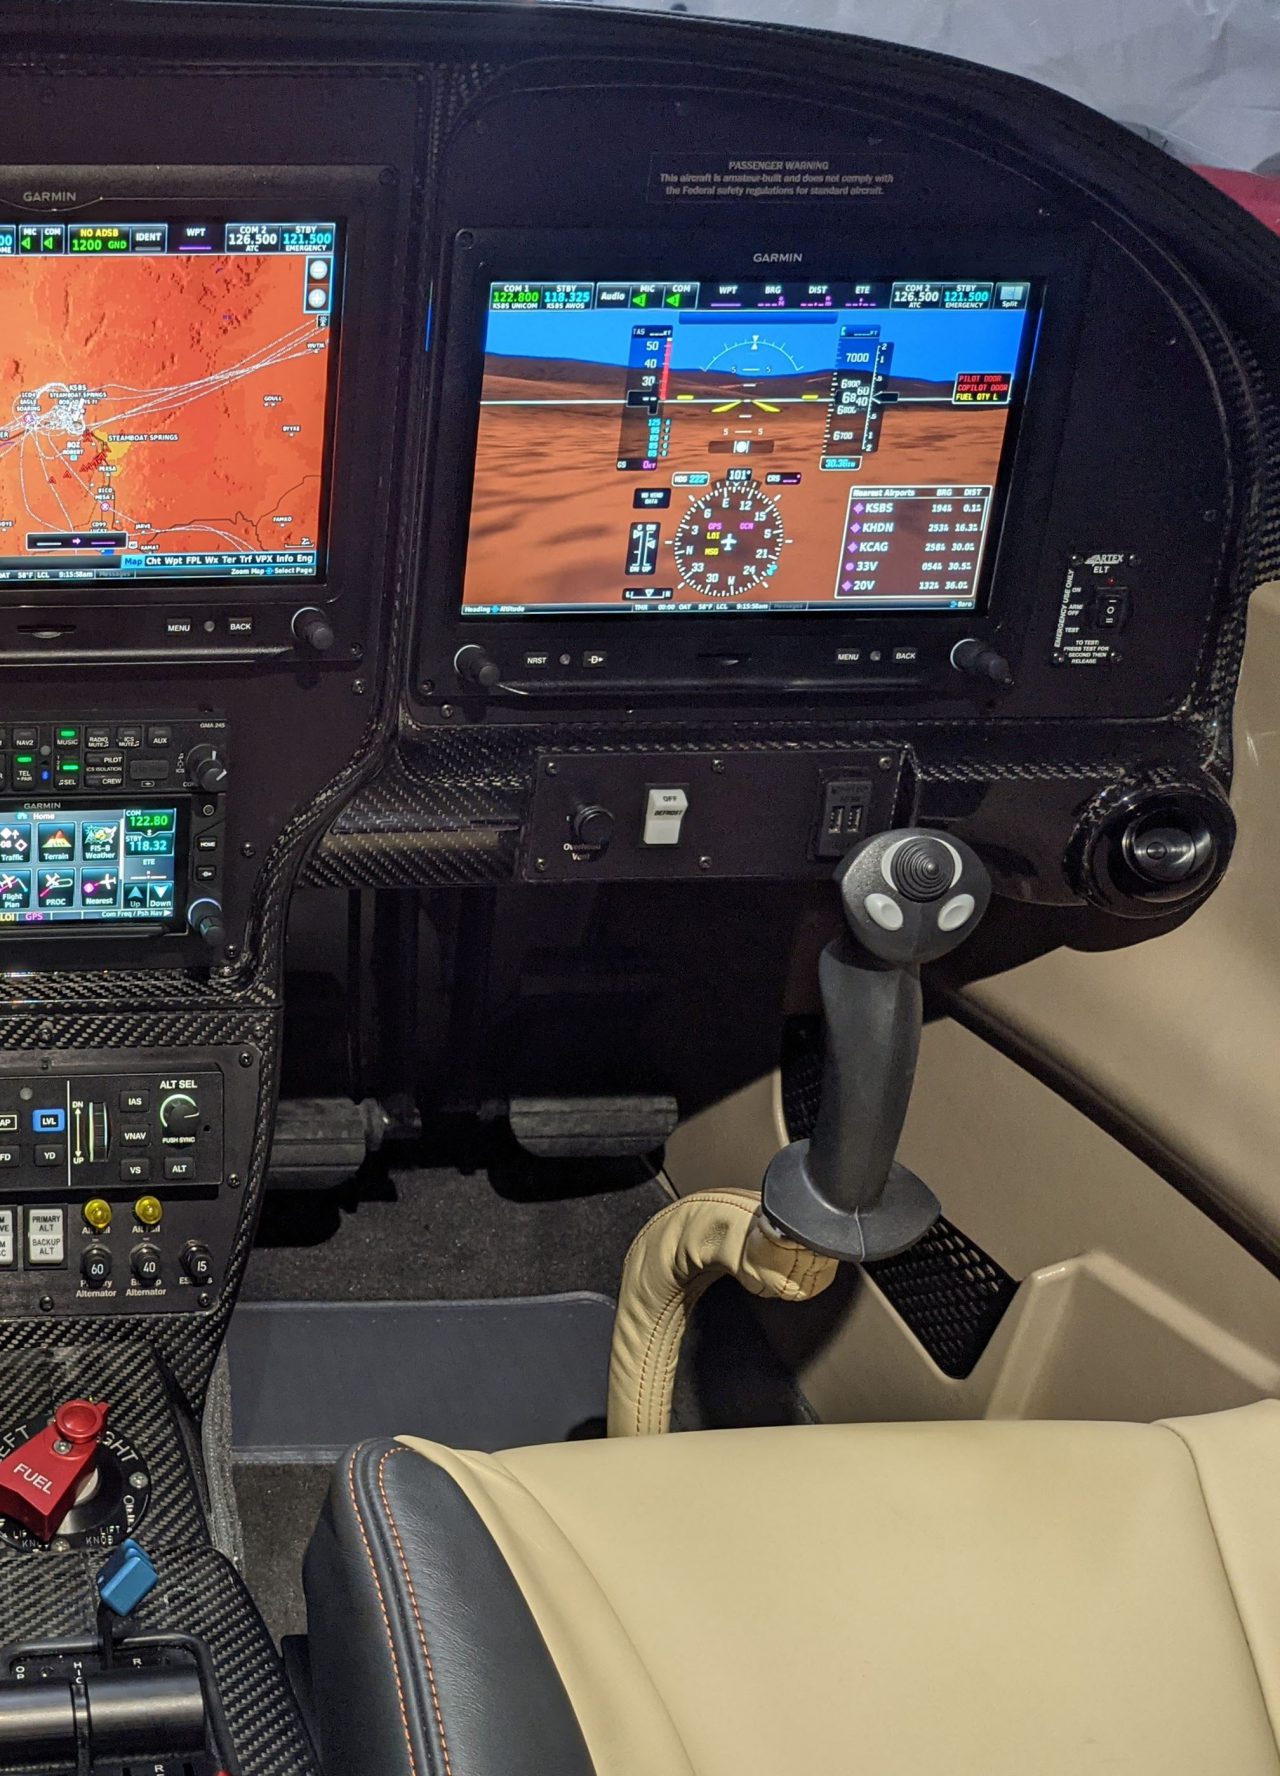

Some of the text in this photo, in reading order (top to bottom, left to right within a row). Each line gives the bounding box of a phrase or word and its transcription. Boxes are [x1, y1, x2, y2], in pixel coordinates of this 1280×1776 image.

[729, 161, 829, 170] PASSENGER WARNING
[660, 174, 893, 185] This aircraft amateur-built and does not comply with
[666, 186, 680, 195] the
[682, 186, 715, 195] Federal
[717, 186, 744, 196] safety
[746, 186, 794, 196] regulations
[796, 186, 809, 195] for
[810, 186, 848, 195] standard
[23, 192, 76, 202] GARMIN
[136, 233, 161, 241] IDENT
[187, 228, 205, 237] WPT
[228, 233, 277, 245] 126.500
[283, 233, 331, 245] 121.500
[72, 239, 102, 251] 1200
[753, 253, 803, 262] GARMIN
[719, 286, 737, 294] WPT
[809, 286, 827, 294] DIST
[493, 292, 538, 302] 122.800
[544, 292, 590, 302] 118.325
[601, 292, 625, 300] Audio
[894, 291, 939, 302] 126.500
[944, 291, 988, 302] 121.500
[846, 353, 869, 363] 7000
[108, 434, 148, 442] STEAMBOAT
[865, 503, 893, 513] KSBS
[862, 523, 894, 532] KHDN
[859, 542, 888, 552] KCAG
[165, 556, 183, 565] Wpt
[186, 556, 202, 564] FPL
[276, 554, 294, 563] Info
[856, 562, 878, 572] 33V
[853, 580, 875, 591] 20V
[130, 816, 168, 826] 122.80
[130, 840, 167, 851] 118.32
[160, 1080, 197, 1089] ALT SEL
[0, 1153, 11, 1161] FD
[32, 1215, 60, 1223] PRIMARY
[91, 1264, 104, 1275] 60
[143, 1262, 156, 1273] 40
[76, 1289, 117, 1298] Alternator
[126, 1288, 166, 1297] Alternator
[13, 1462, 52, 1494] FUEL
[86, 1535, 113, 1546] KNOB
